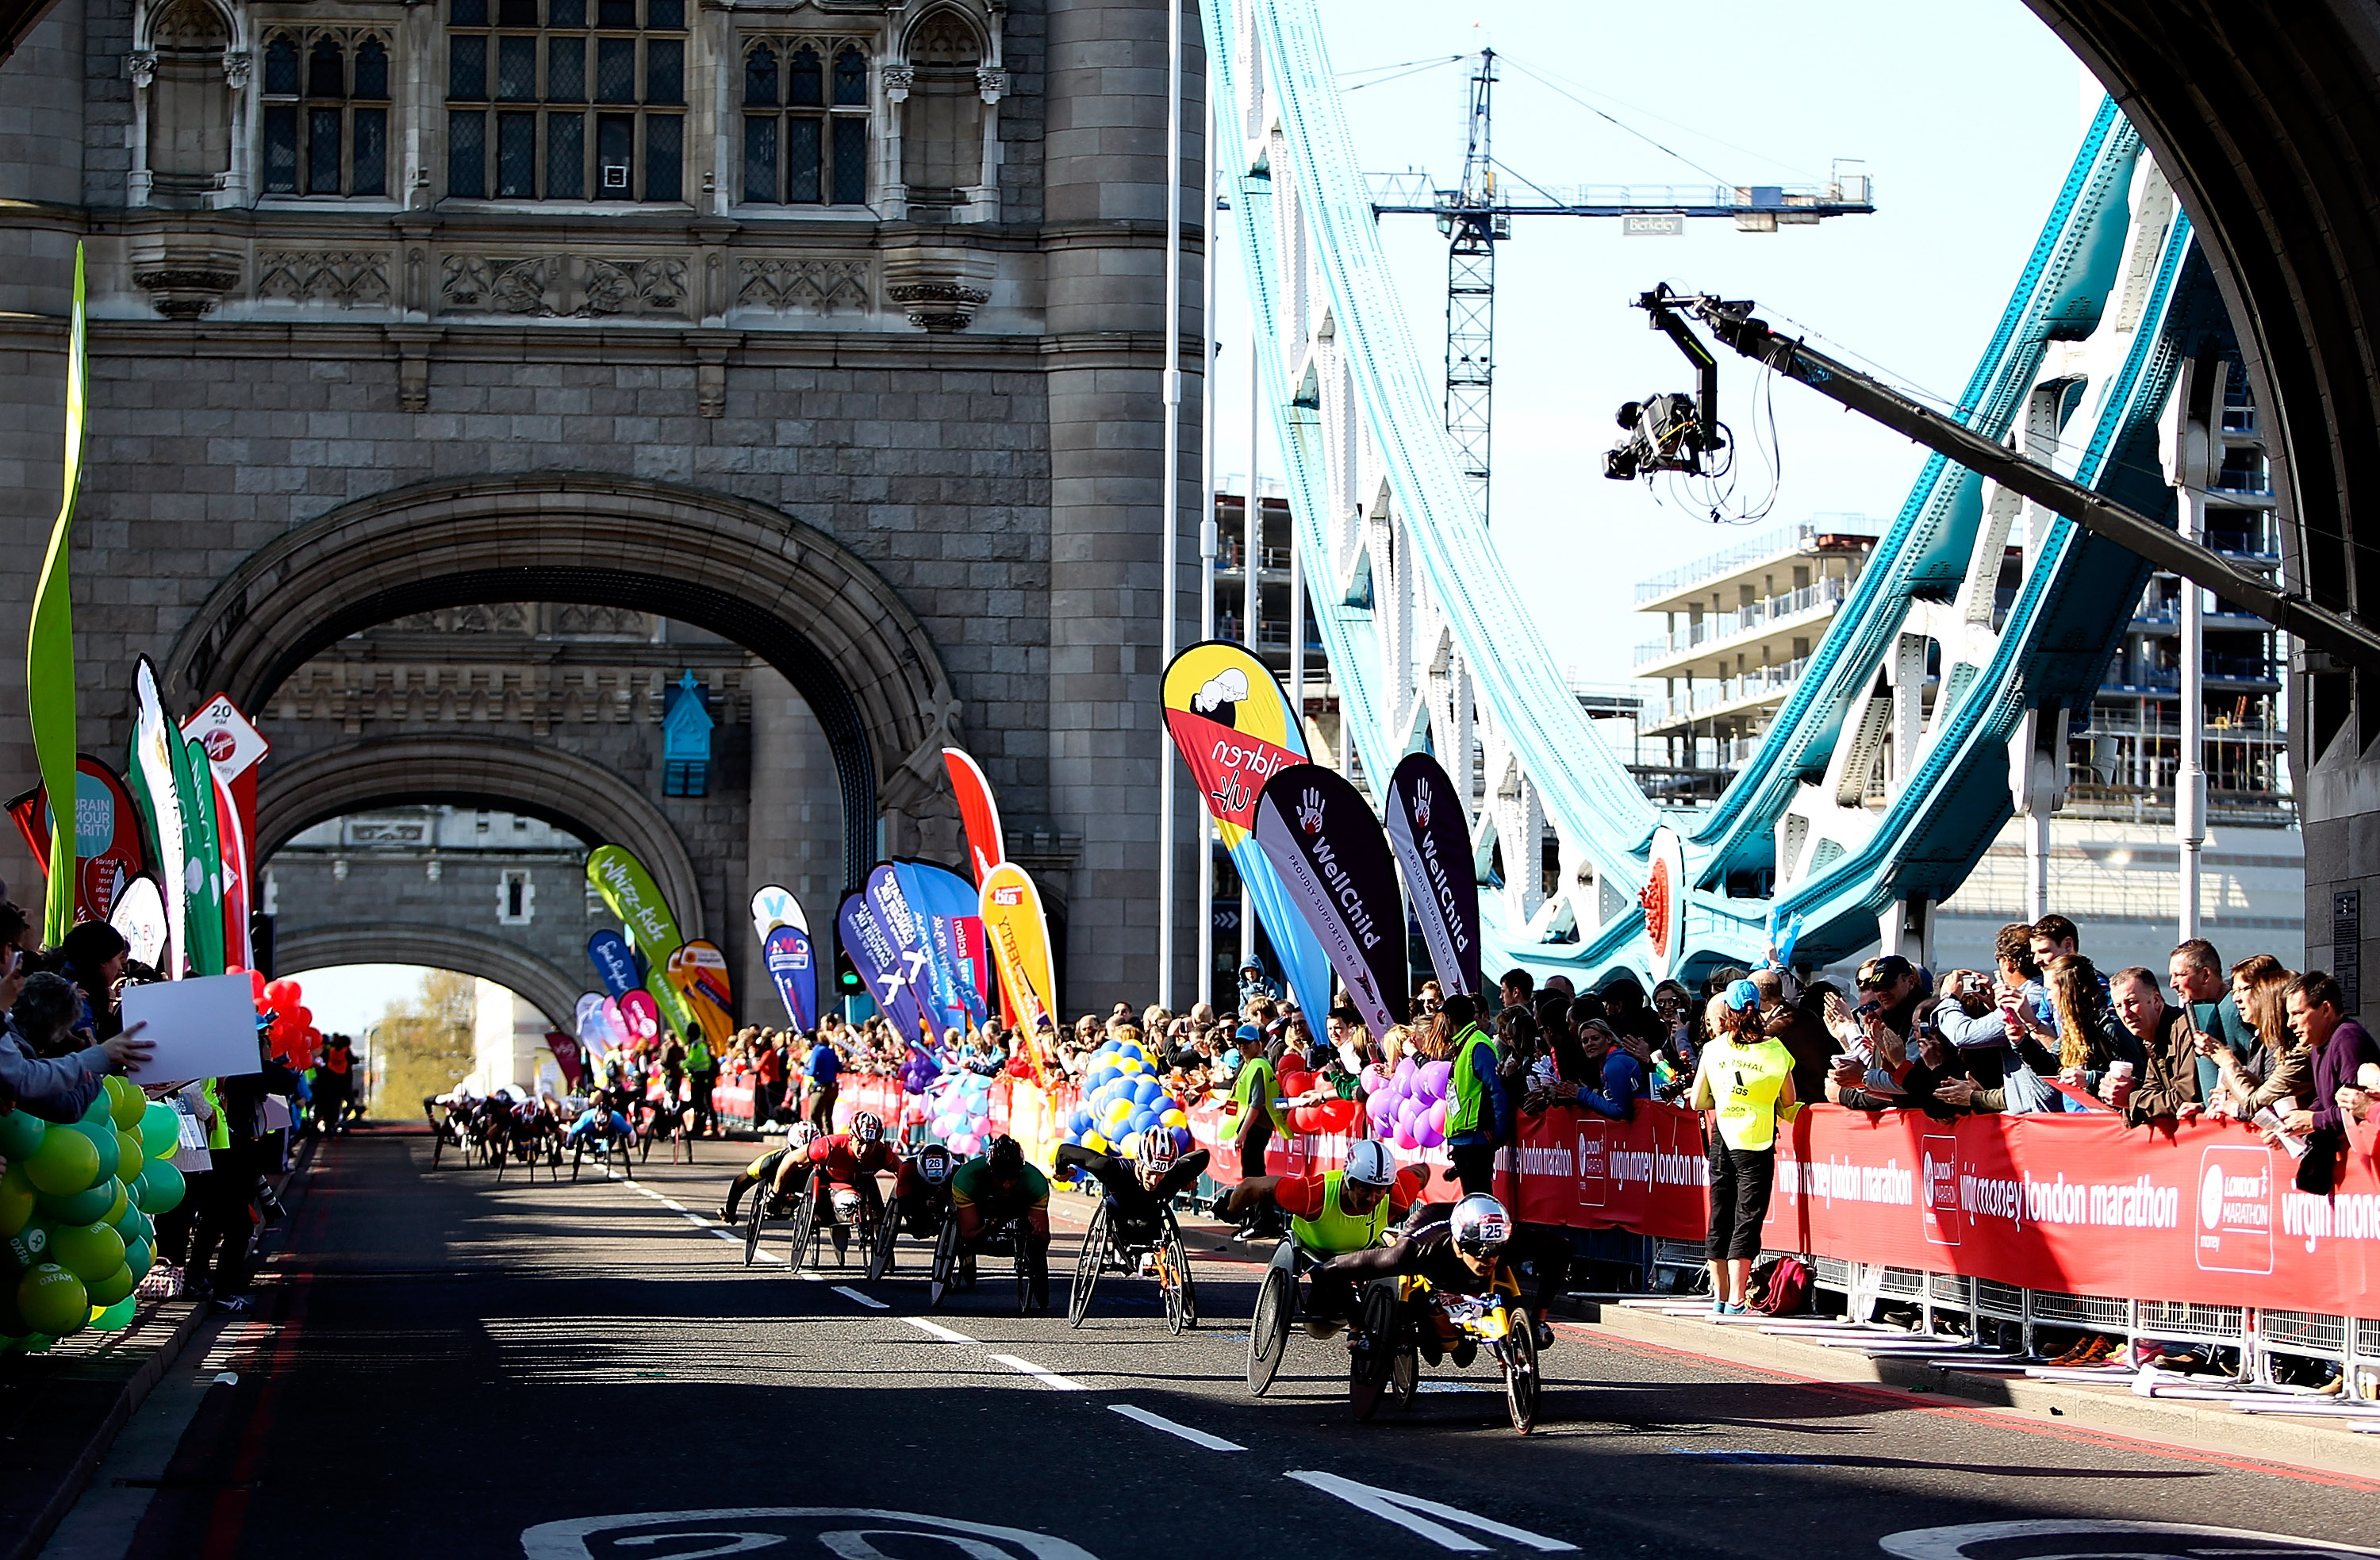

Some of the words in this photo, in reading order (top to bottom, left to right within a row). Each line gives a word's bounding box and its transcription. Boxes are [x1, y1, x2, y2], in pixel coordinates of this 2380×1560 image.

[1629, 217, 1676, 235] Berkeley
[212, 705, 232, 718] 20
[204, 730, 236, 759] Virgin
[217, 766, 236, 776] ney
[75, 798, 109, 812] RAIN
[75, 811, 110, 824] MOUR
[75, 824, 110, 836] ARITY
[1312, 836, 1381, 950] WellChild
[1407, 848, 1426, 893] PROUDLY
[1425, 896, 1447, 955] SUPPORTED
[1422, 830, 1468, 953] WellChild
[1288, 854, 1316, 897] PROUDLY
[1314, 898, 1348, 952] SUPPORTED
[1345, 954, 1357, 966] BY
[1718, 1059, 1765, 1074] MRSHAL
[928, 1158, 940, 1168] 26
[1153, 1161, 1167, 1172] 30
[1610, 1140, 1629, 1191] virgin
[1630, 1151, 1654, 1193] money
[1654, 1143, 1691, 1185] london
[1778, 1149, 1802, 1206] virgin
[1830, 1154, 1861, 1201] london
[1862, 1158, 1913, 1205] marathon
[2224, 1176, 2259, 1198] LONDON
[1976, 1178, 2023, 1233] money
[2024, 1170, 2086, 1224] london
[2089, 1174, 2178, 1228] marathon
[2222, 1202, 2268, 1226] MARATHON
[2281, 1178, 2332, 1254] virgin
[2334, 1193, 2380, 1239] mone
[1485, 1224, 1503, 1239] 25
[10, 1238, 32, 1267] OXFAM
[2200, 1235, 2221, 1253] money
[39, 1273, 75, 1286] OXFAM
